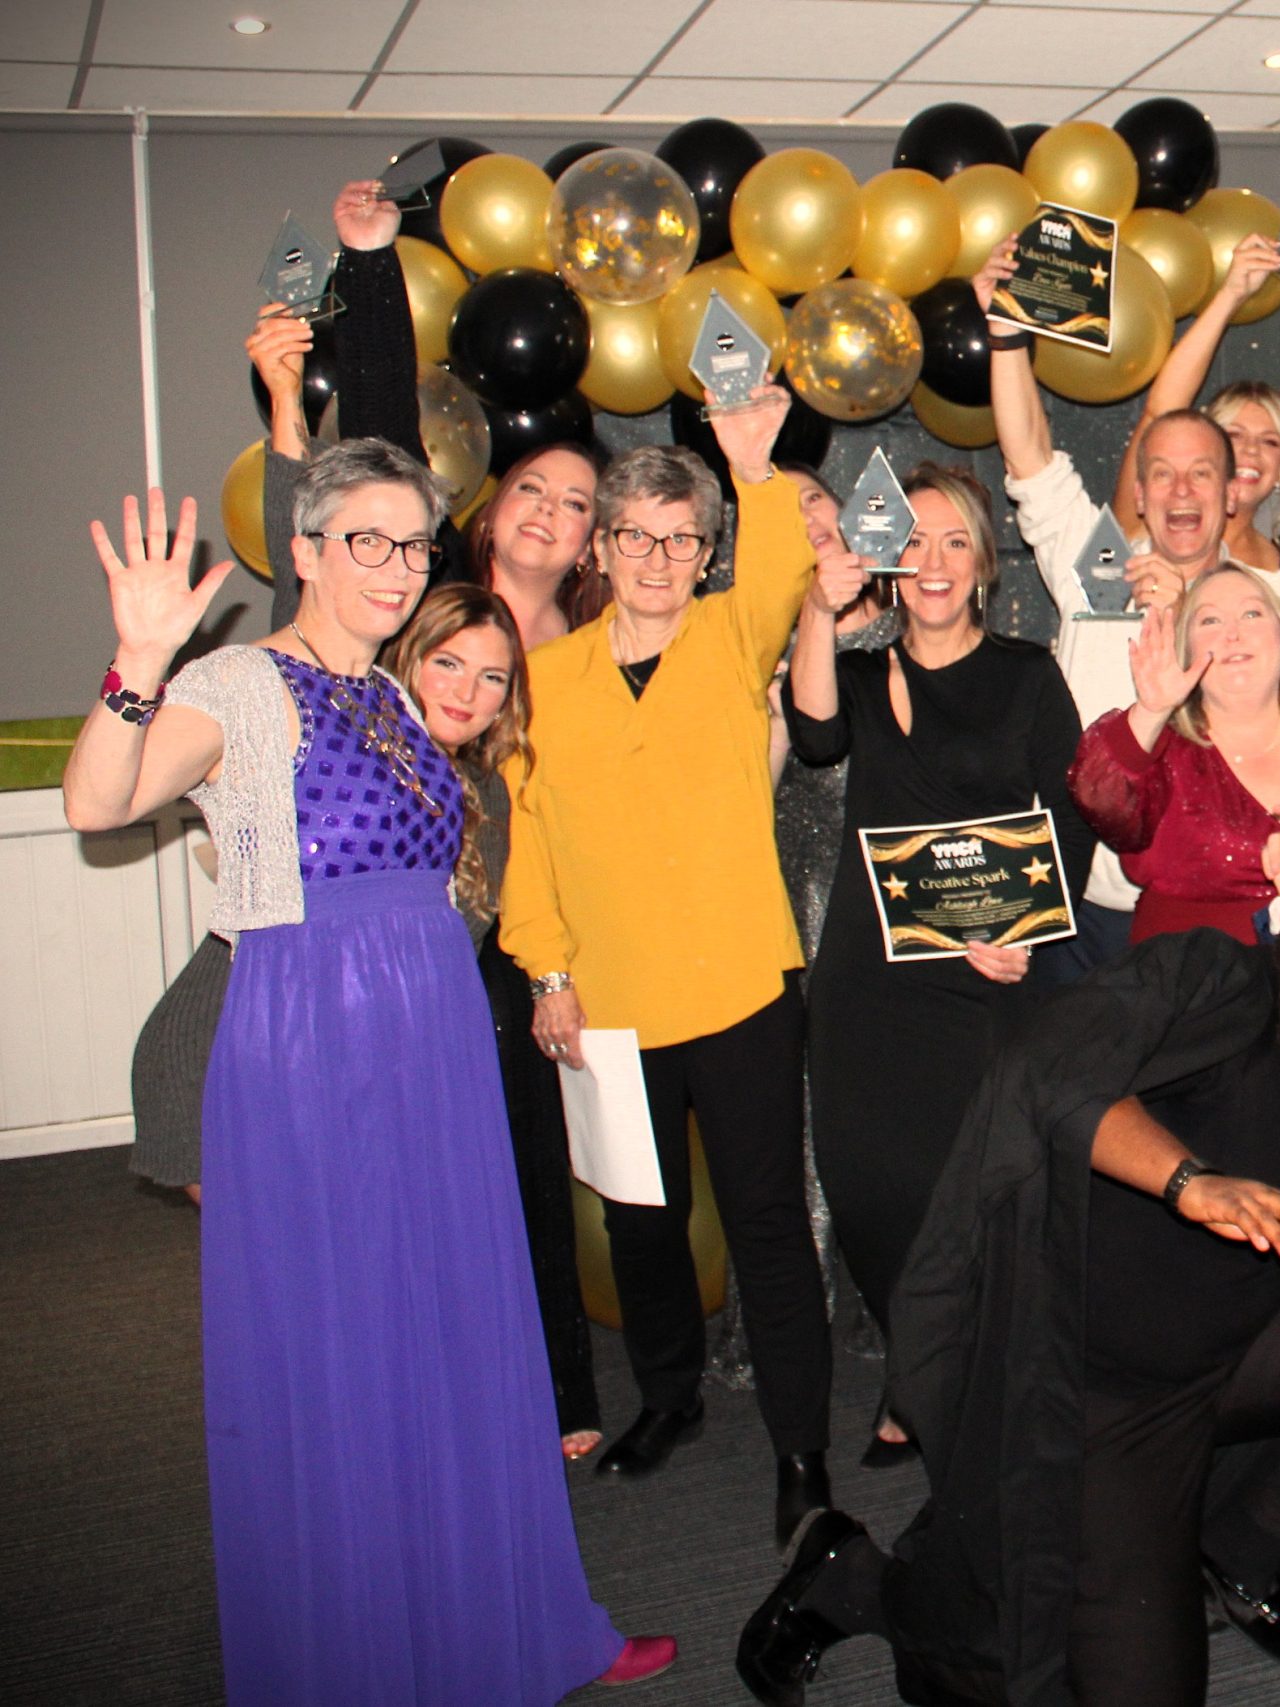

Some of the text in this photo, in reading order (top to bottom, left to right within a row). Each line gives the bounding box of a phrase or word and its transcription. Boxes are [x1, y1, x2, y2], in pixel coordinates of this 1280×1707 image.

[1047, 252, 1089, 273] Champion
[930, 837, 983, 859] YMCA
[933, 854, 987, 871] AWARDS
[919, 867, 1010, 890] Creative Spark
